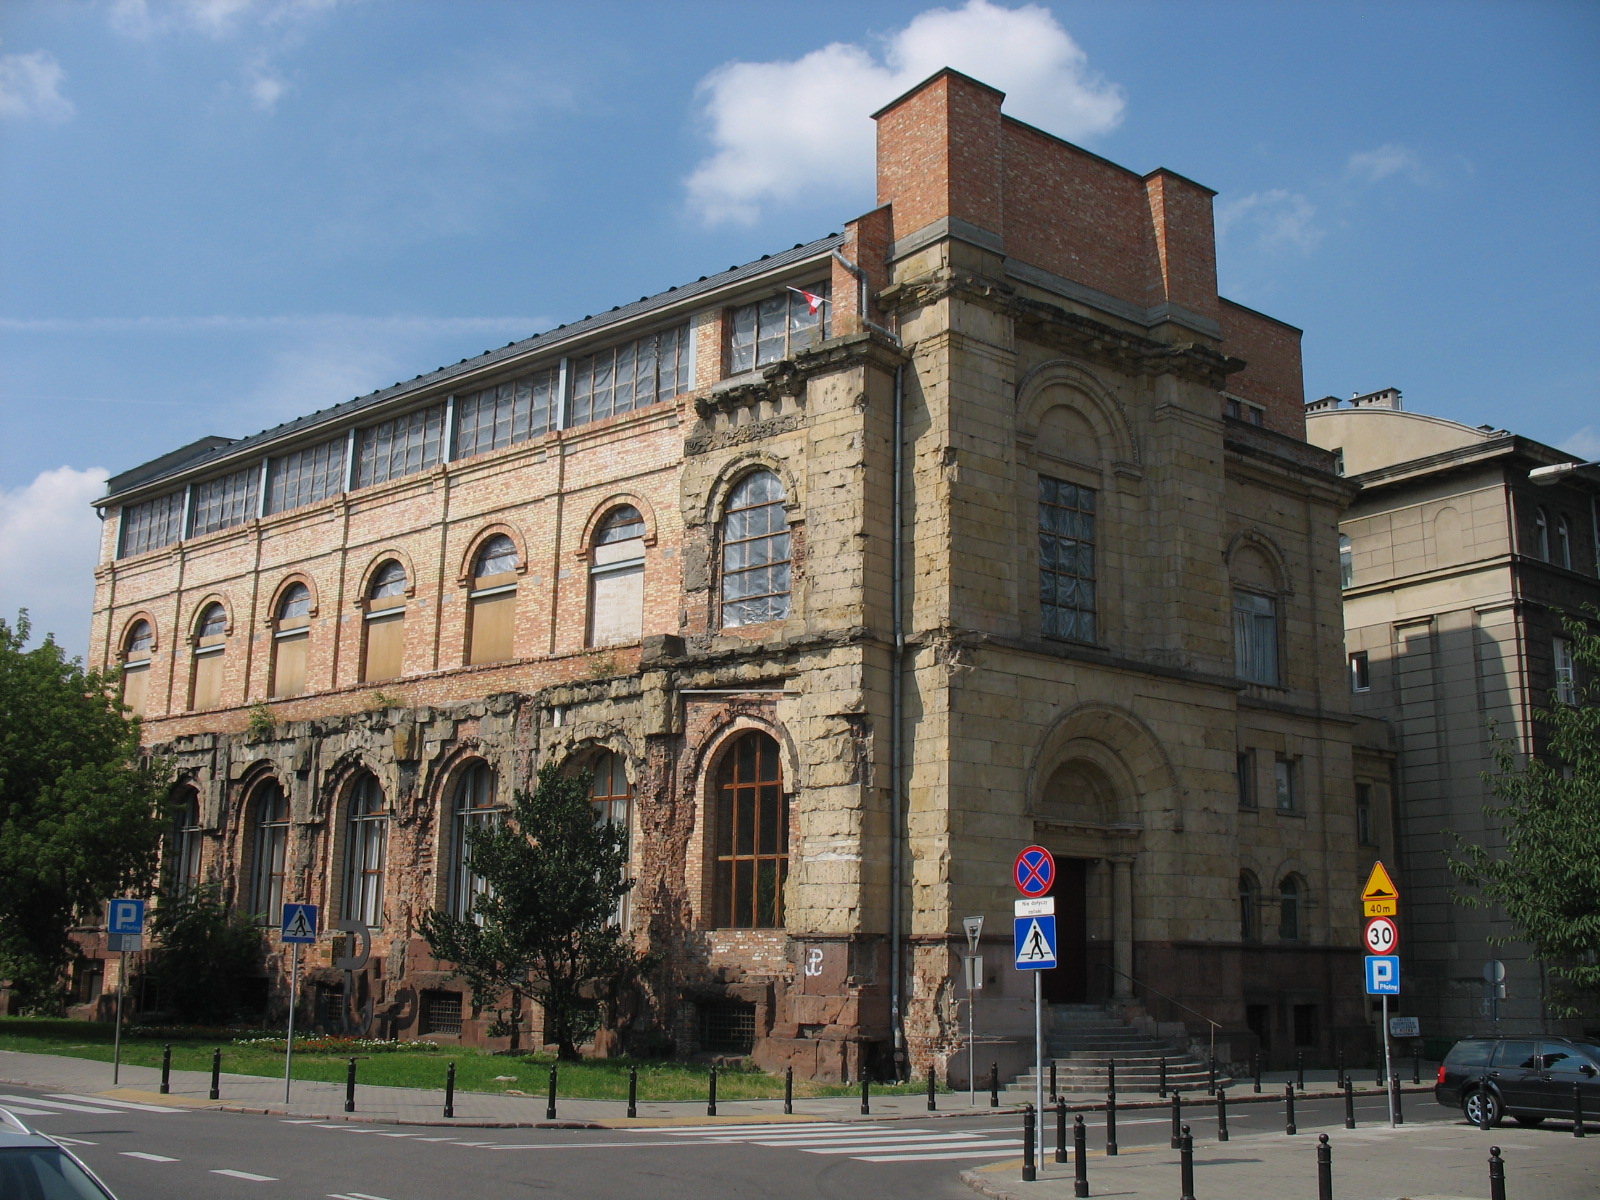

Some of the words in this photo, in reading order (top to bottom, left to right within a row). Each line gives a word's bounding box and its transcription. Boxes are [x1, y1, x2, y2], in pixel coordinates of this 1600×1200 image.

[116, 903, 137, 929] P
[1370, 927, 1392, 945] 30
[1372, 960, 1392, 990] P
